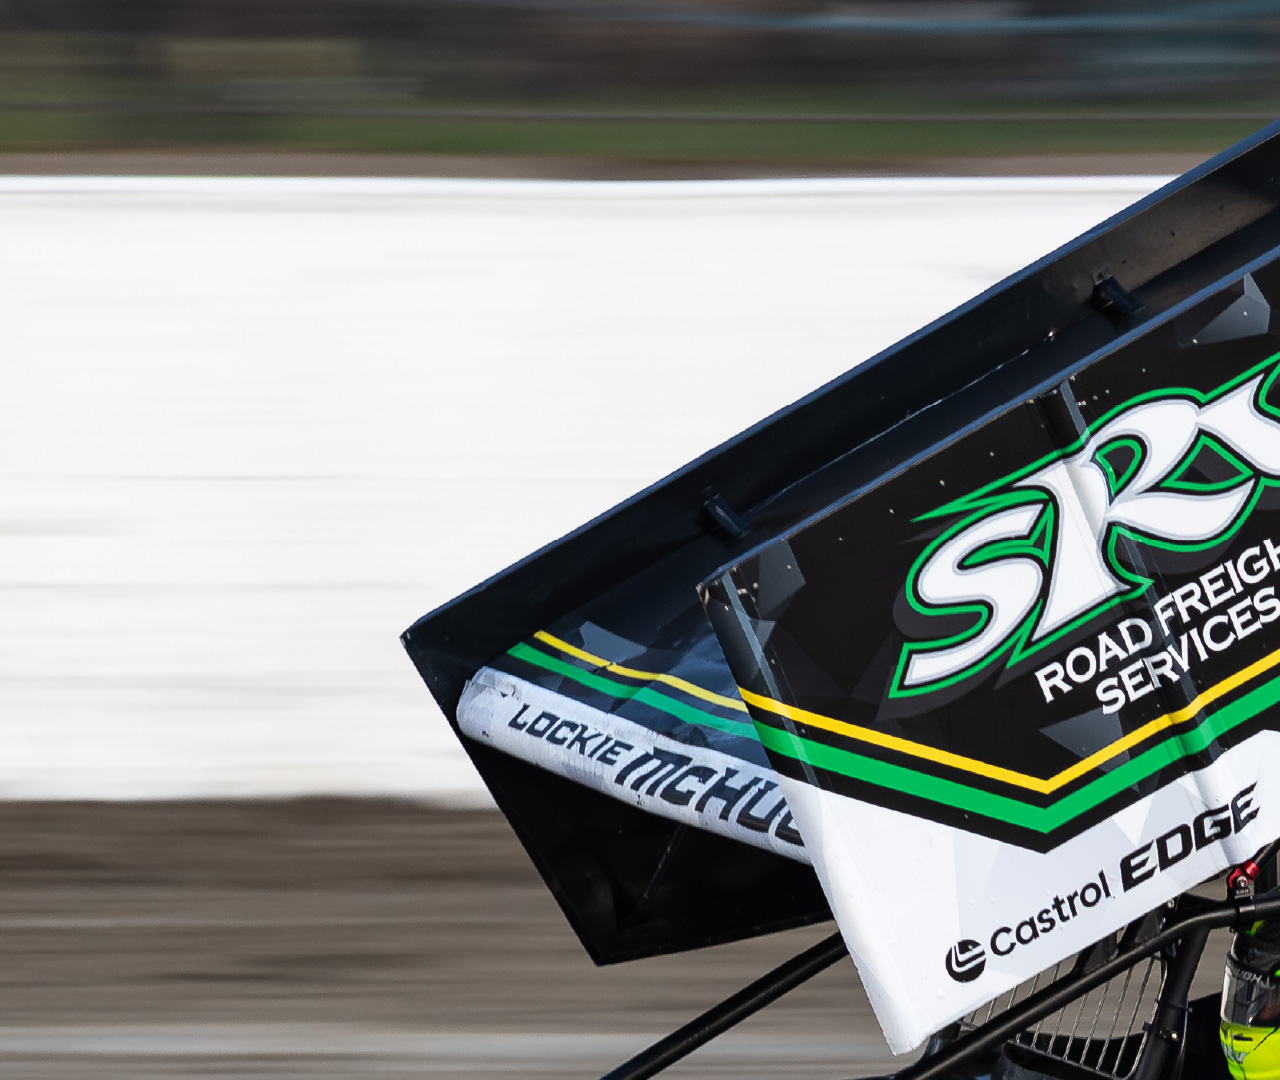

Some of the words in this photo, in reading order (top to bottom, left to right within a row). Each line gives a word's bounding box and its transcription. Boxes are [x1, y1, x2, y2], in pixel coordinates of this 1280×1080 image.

[1034, 616, 1154, 704] ROAD
[507, 703, 631, 767] LOCKIE
[614, 746, 808, 849] MCHU
[990, 870, 1116, 958] Castrol
[1119, 780, 1261, 893] EDGE
